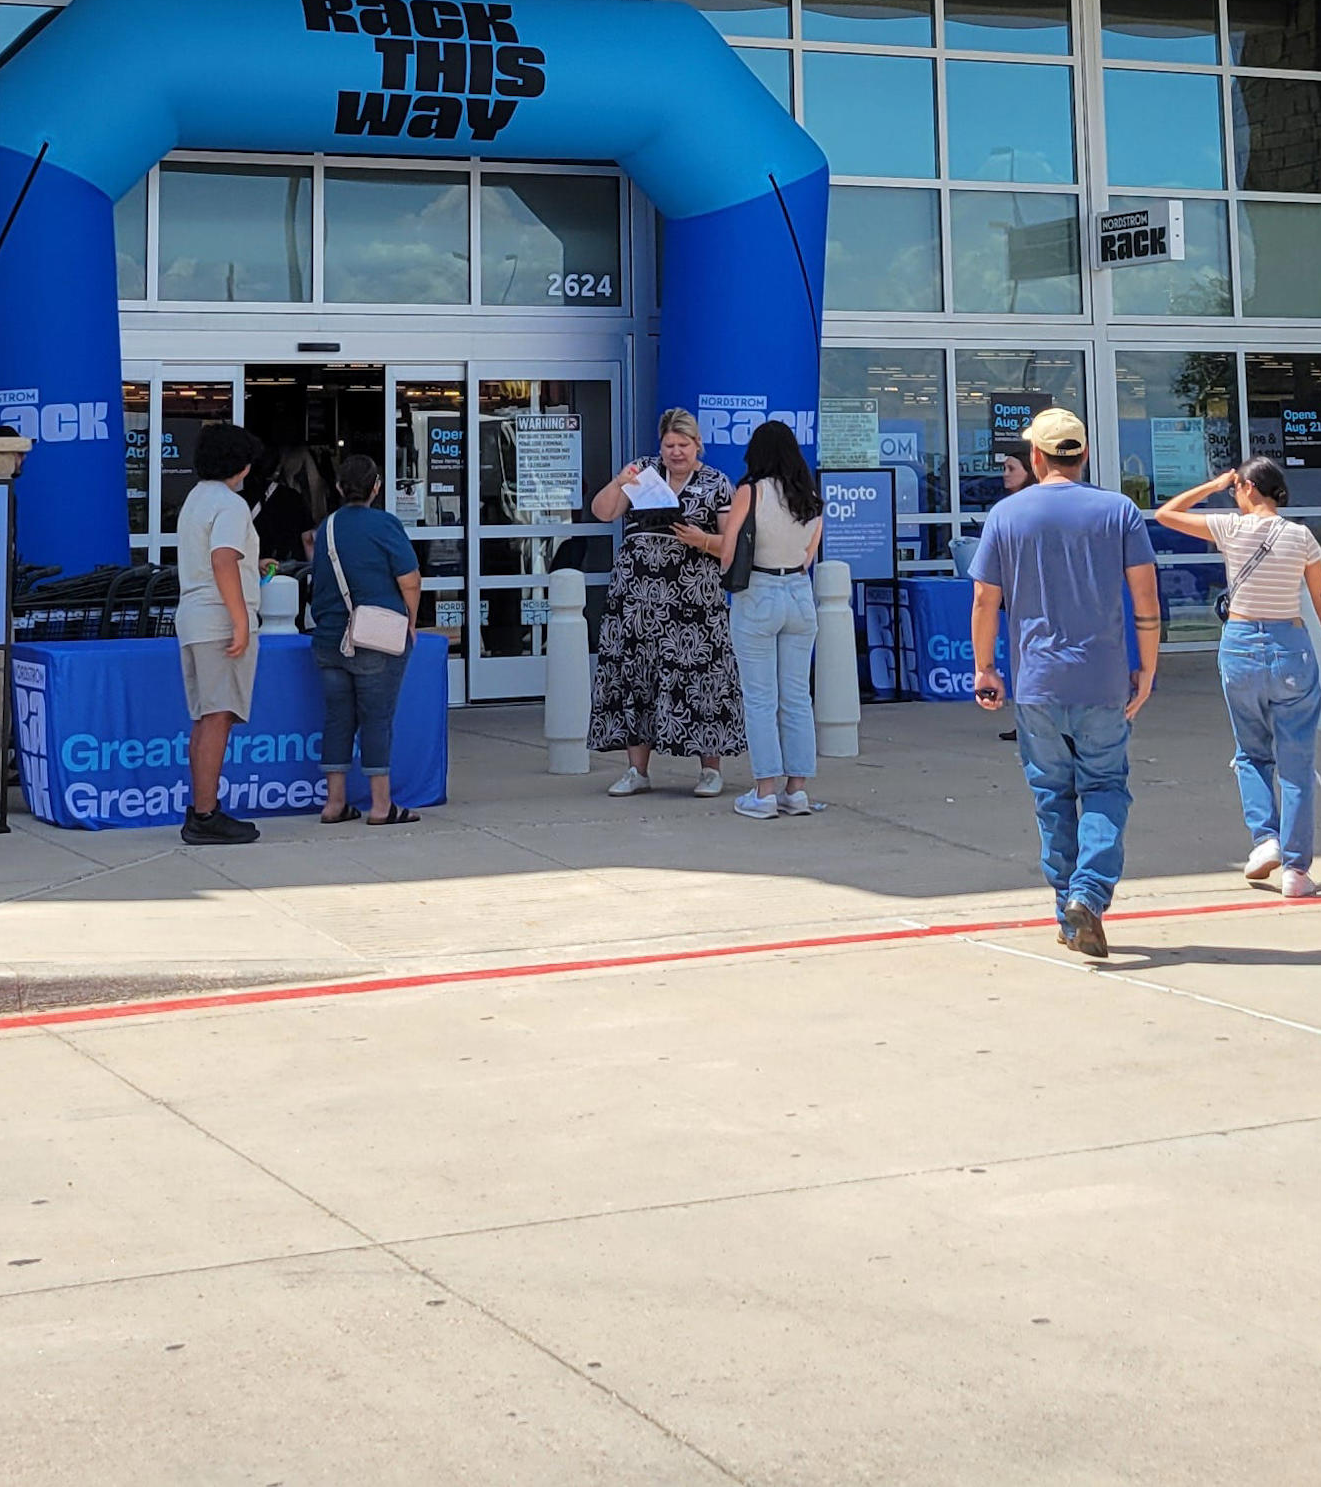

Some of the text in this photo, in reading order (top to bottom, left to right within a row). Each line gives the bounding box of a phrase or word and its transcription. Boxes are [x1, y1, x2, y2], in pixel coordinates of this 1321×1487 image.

[374, 36, 546, 98] THIS
[1102, 213, 1148, 231] NORDSTROM
[547, 273, 612, 297] 2624
[701, 396, 765, 407] NORDSTROM
[994, 403, 1031, 416] Opens
[1283, 409, 1317, 421] Opens
[518, 417, 565, 430] WARNING
[994, 416, 1020, 430] Aug.
[1284, 421, 1307, 435] Aug.
[125, 431, 173, 446] Ops
[430, 428, 463, 443] Ope
[162, 445, 180, 459] 21
[430, 442, 462, 457] Aug.
[825, 484, 877, 501] Photo
[826, 501, 856, 522] Op!
[927, 634, 1005, 662] Gret
[61, 731, 190, 773] Great
[64, 780, 190, 820] Great
